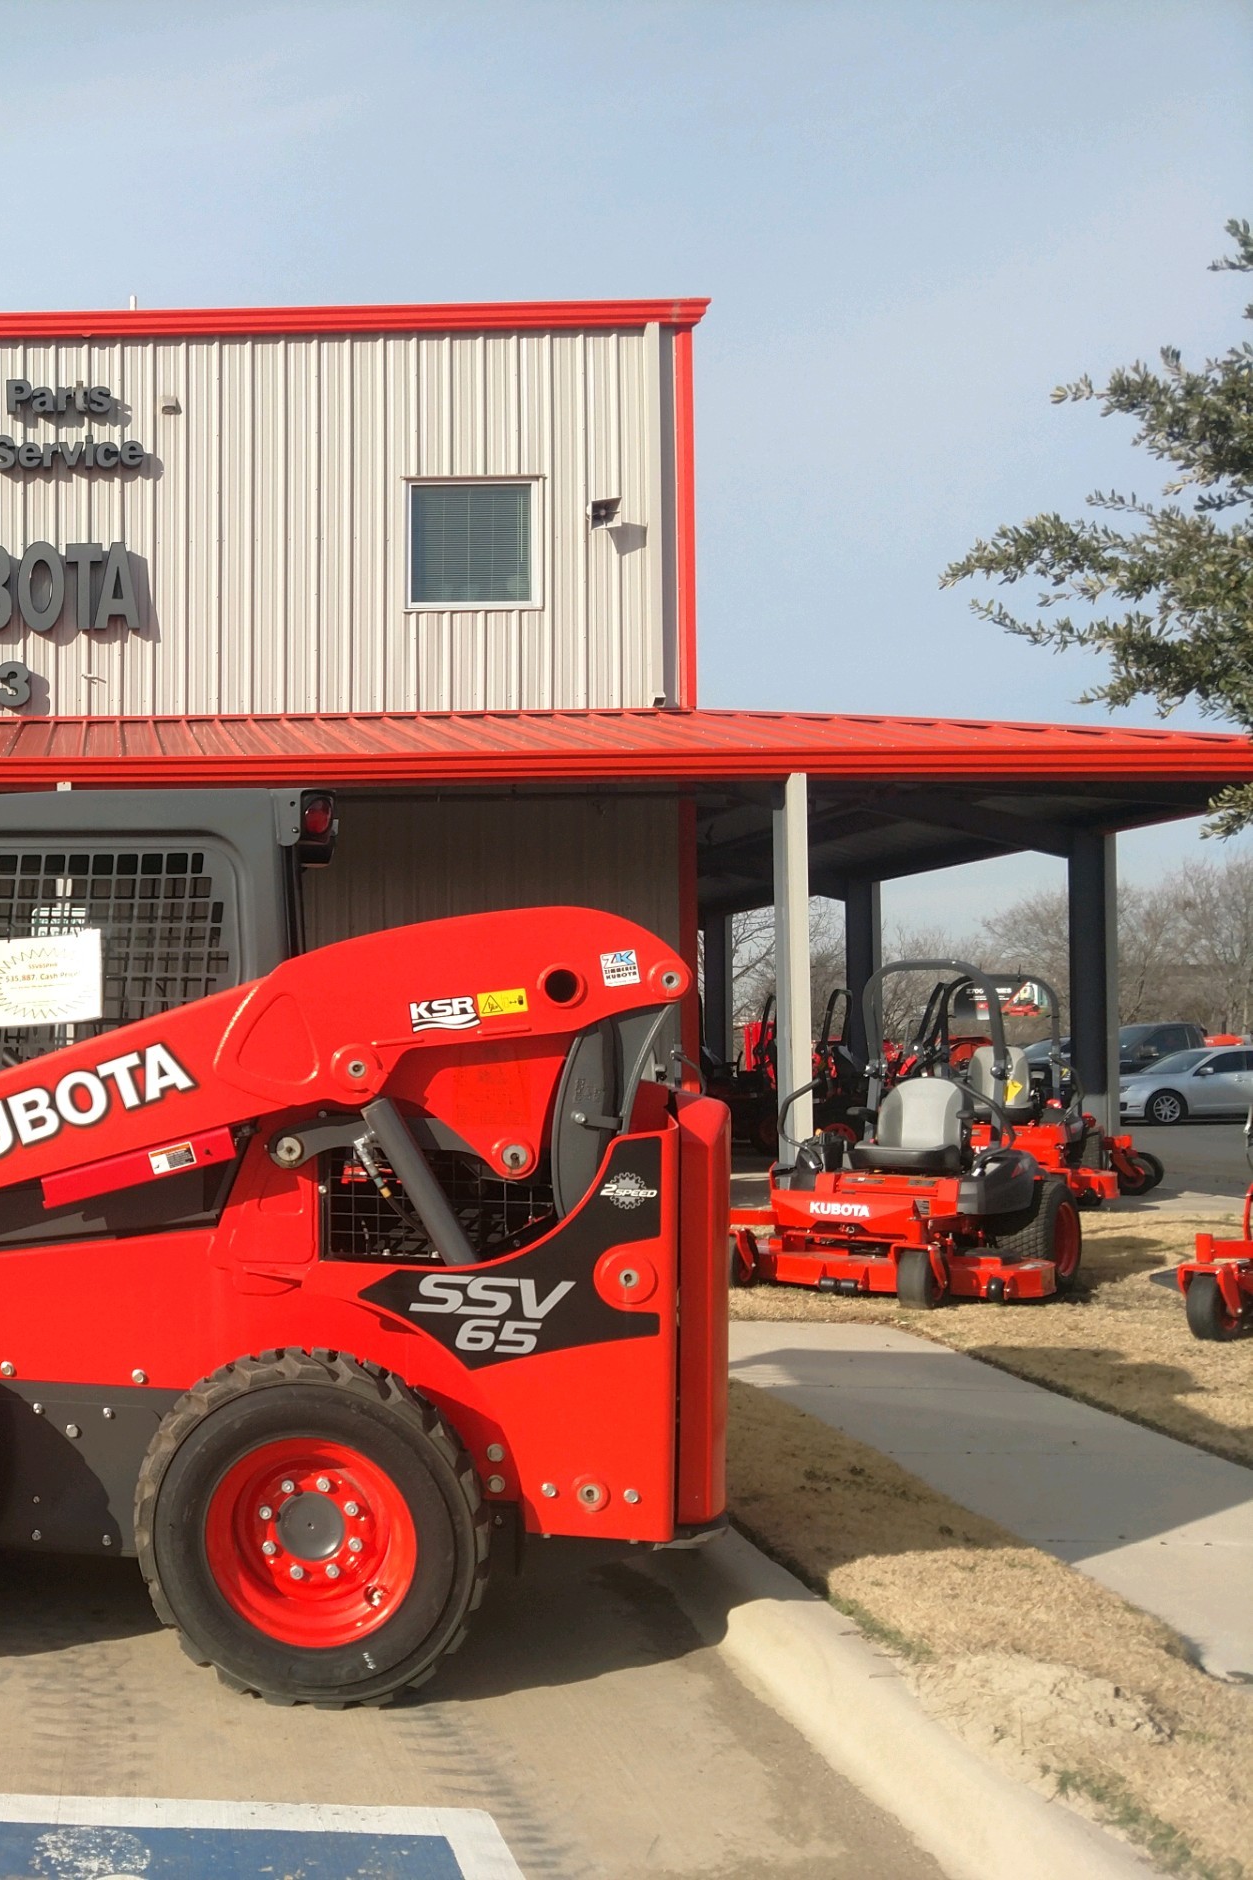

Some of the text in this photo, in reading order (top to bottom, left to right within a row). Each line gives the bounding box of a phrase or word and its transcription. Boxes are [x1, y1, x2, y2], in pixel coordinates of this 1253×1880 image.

[7, 379, 112, 415] Parts
[39, 972, 58, 981] Cash
[604, 966, 637, 975] ZIMMERER
[606, 971, 637, 980] KUBOTA
[409, 996, 475, 1020] KSR
[809, 1202, 870, 1217] KUBOTA
[408, 1274, 577, 1319] SSV
[455, 1319, 542, 1354] 65
